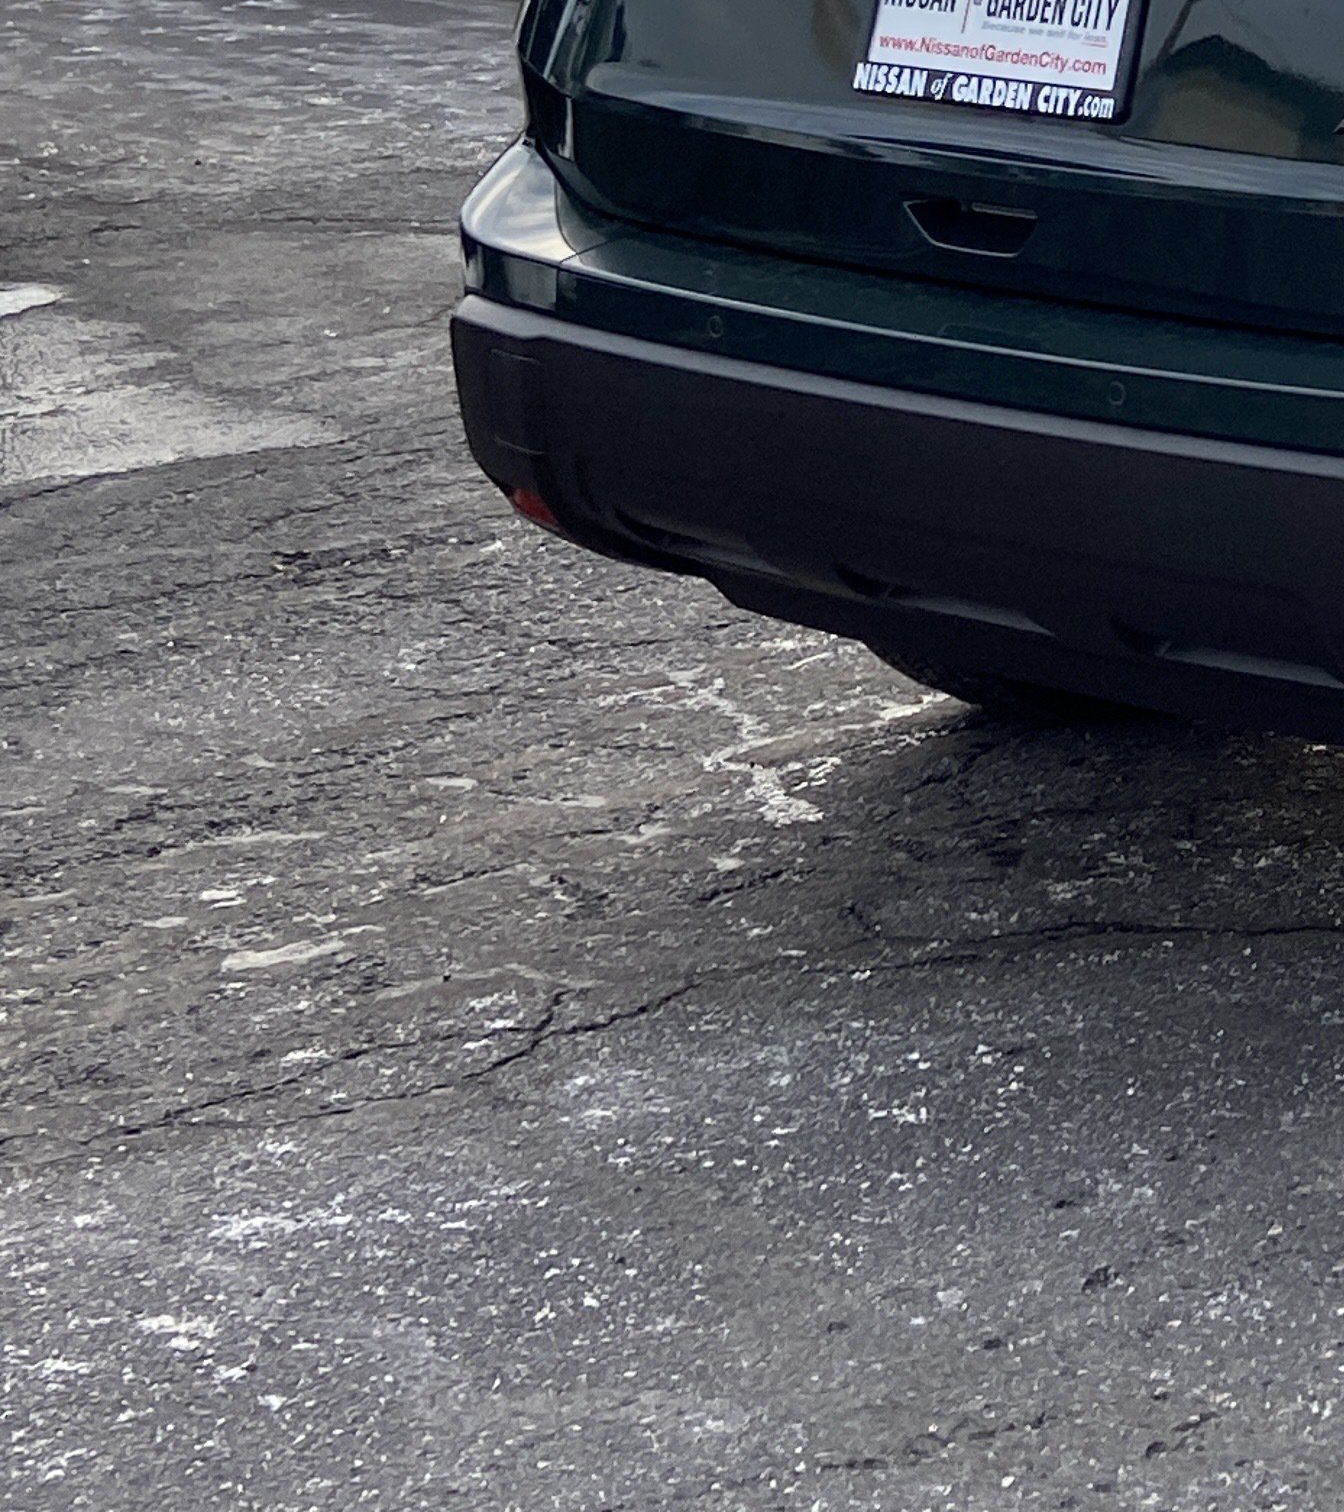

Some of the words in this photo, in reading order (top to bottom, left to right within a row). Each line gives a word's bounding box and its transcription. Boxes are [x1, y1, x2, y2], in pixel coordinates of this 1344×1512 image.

[879, 36, 1107, 76] www.NissanofGardenCity.com
[853, 62, 928, 97] NISSAN
[930, 73, 954, 100] of
[952, 75, 1032, 111] GARDEN
[1037, 89, 1115, 119] CITY.com
